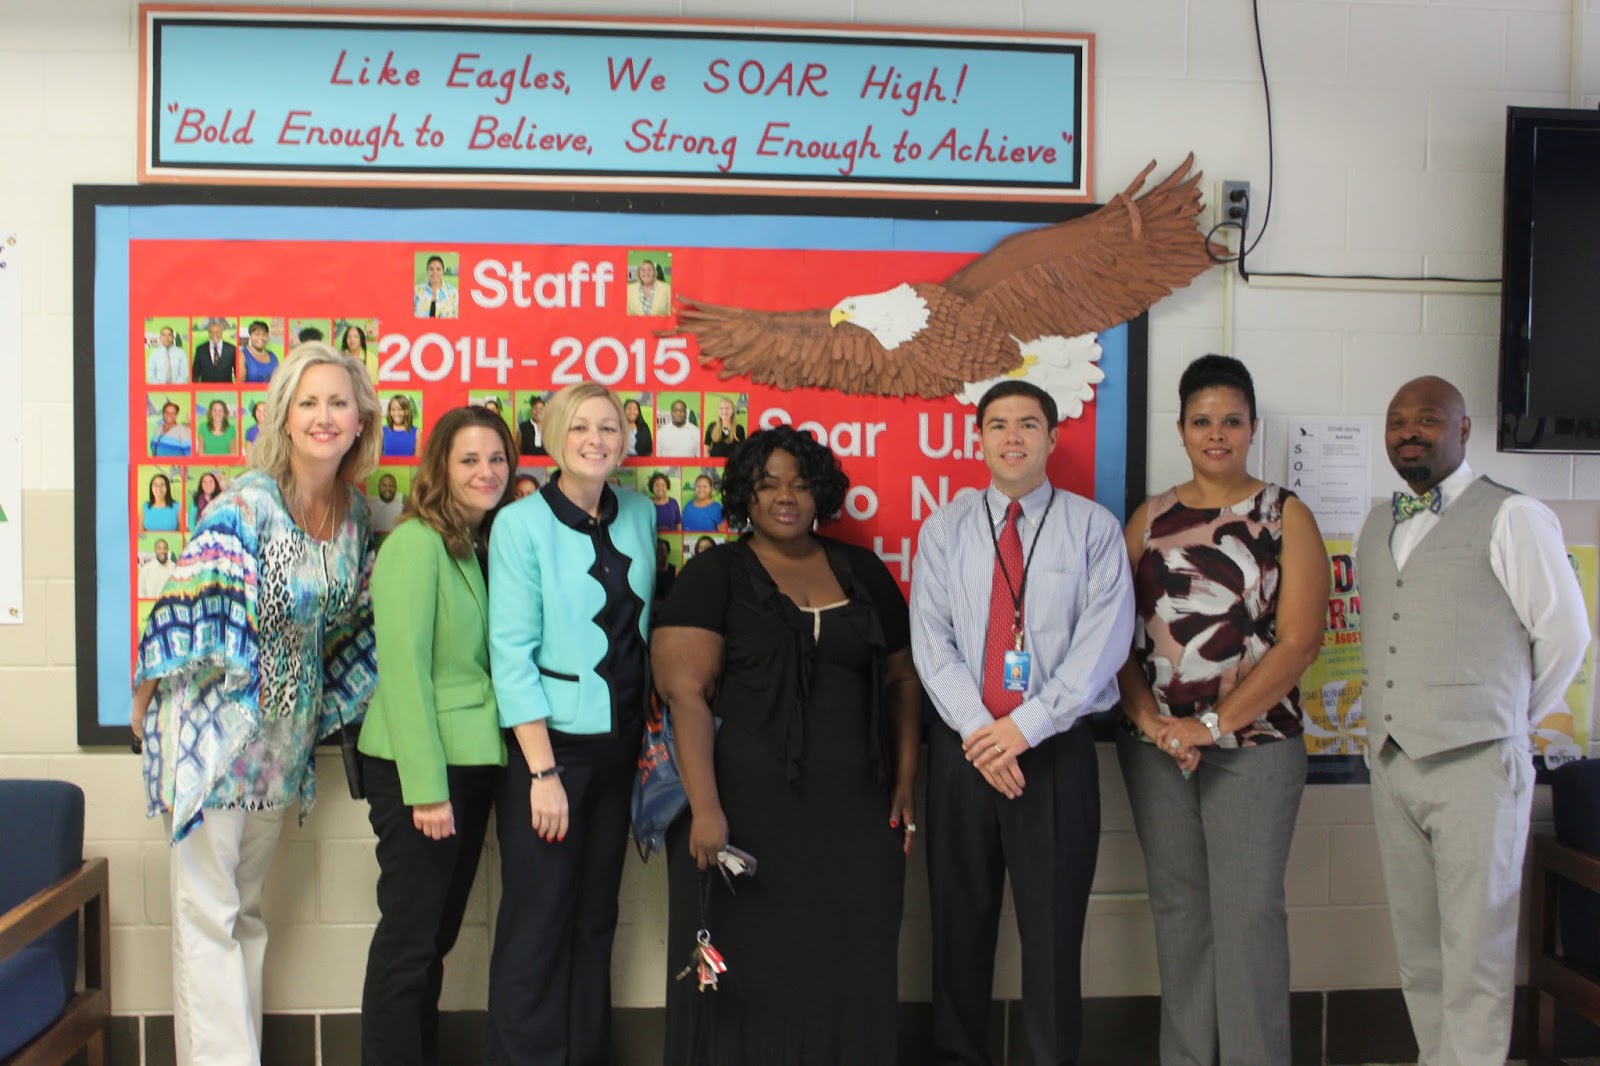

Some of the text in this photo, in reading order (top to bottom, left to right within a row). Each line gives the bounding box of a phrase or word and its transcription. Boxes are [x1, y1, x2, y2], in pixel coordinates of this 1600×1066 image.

[330, 50, 968, 116] Like Eagles, We SOAR High!
[167, 103, 1073, 176] "Bold Enough to Believe, Strong Enough to Achieve"
[471, 259, 614, 308] Staff
[1294, 444, 1302, 454] S
[1293, 461, 1303, 471] O
[1294, 478, 1301, 487] A
